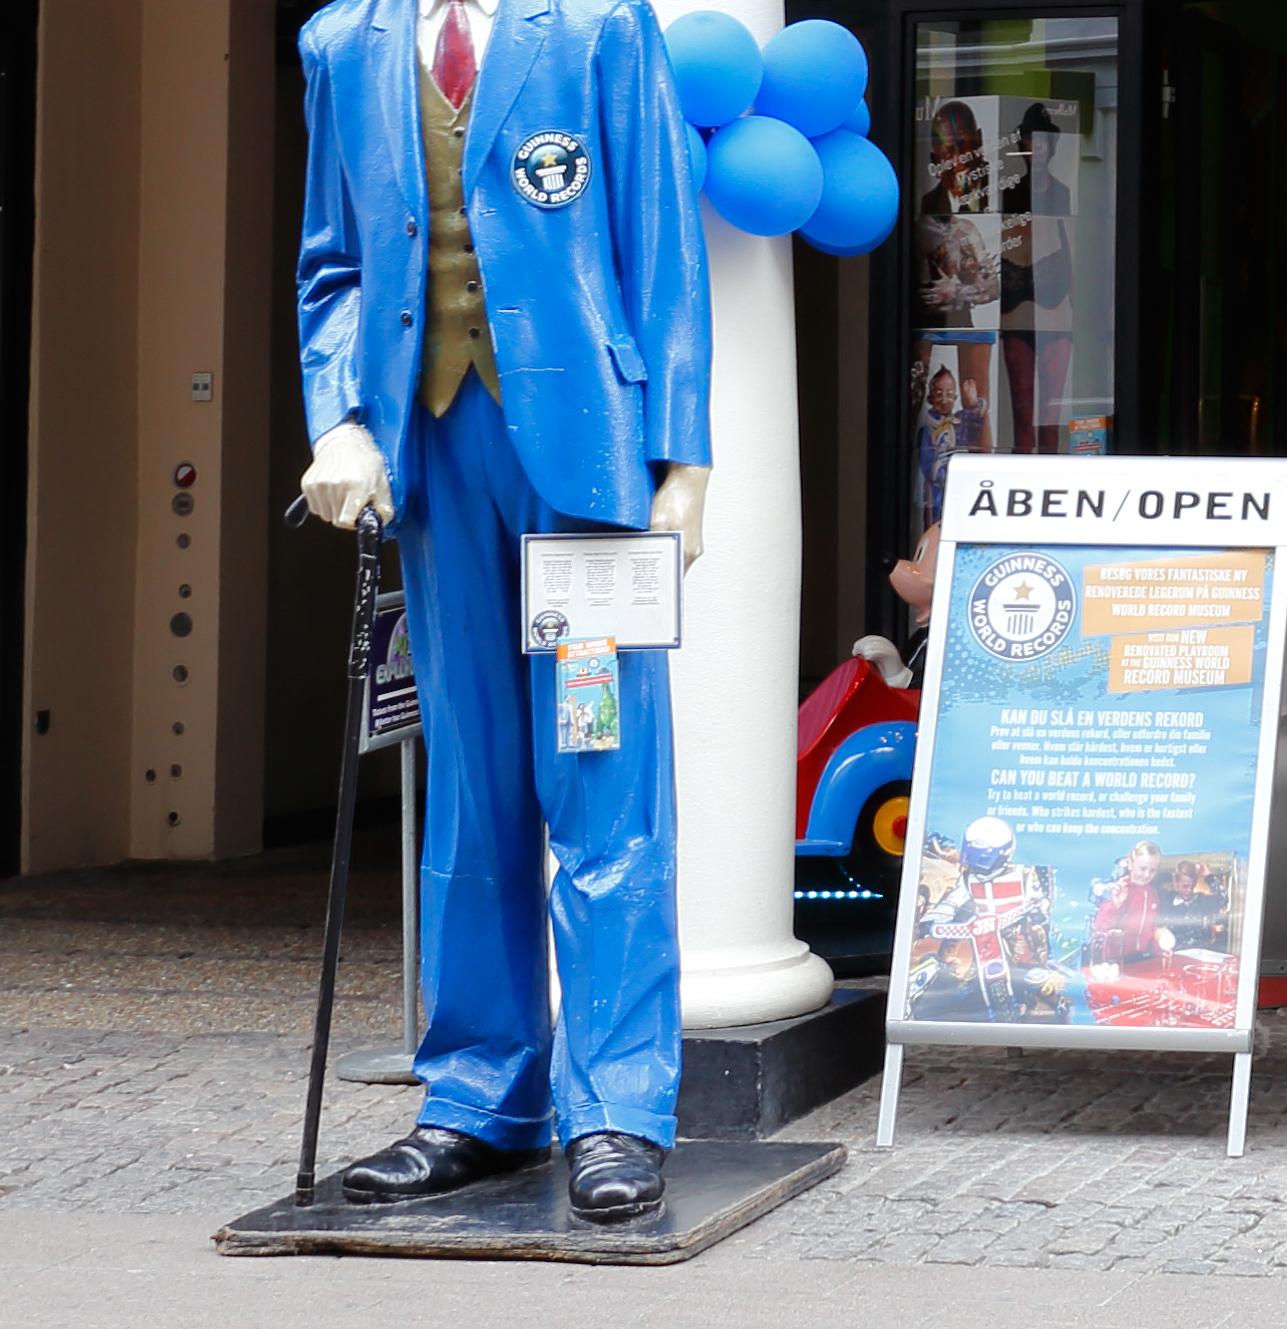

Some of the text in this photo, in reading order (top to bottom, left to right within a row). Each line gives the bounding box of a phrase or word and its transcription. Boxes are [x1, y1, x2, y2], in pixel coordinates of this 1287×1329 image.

[518, 133, 578, 160] GUINNESS
[515, 157, 587, 203] WORLD RECORDS
[984, 557, 1065, 587] GUINNESS
[1135, 568, 1165, 580] VORES
[1168, 569, 1231, 581] FANTASTISKE
[1210, 587, 1261, 599] GUINNESS
[1112, 604, 1230, 616] WORLD RECORD MUSEUM
[972, 599, 1071, 657] WORLD RECORDS
[1181, 630, 1207, 643] NEW
[1124, 646, 1228, 657] RENOVATED PLAYROOM
[1143, 657, 1192, 669] GUINNESS
[1195, 658, 1229, 670] WORLD
[1124, 670, 1224, 684] RECORD MUSEUM
[1001, 707, 1202, 727] KAN DU SLÅ EN VERDENS REKORD
[991, 769, 1195, 788] CAN YOU BEAT A WORLD RECORD?
